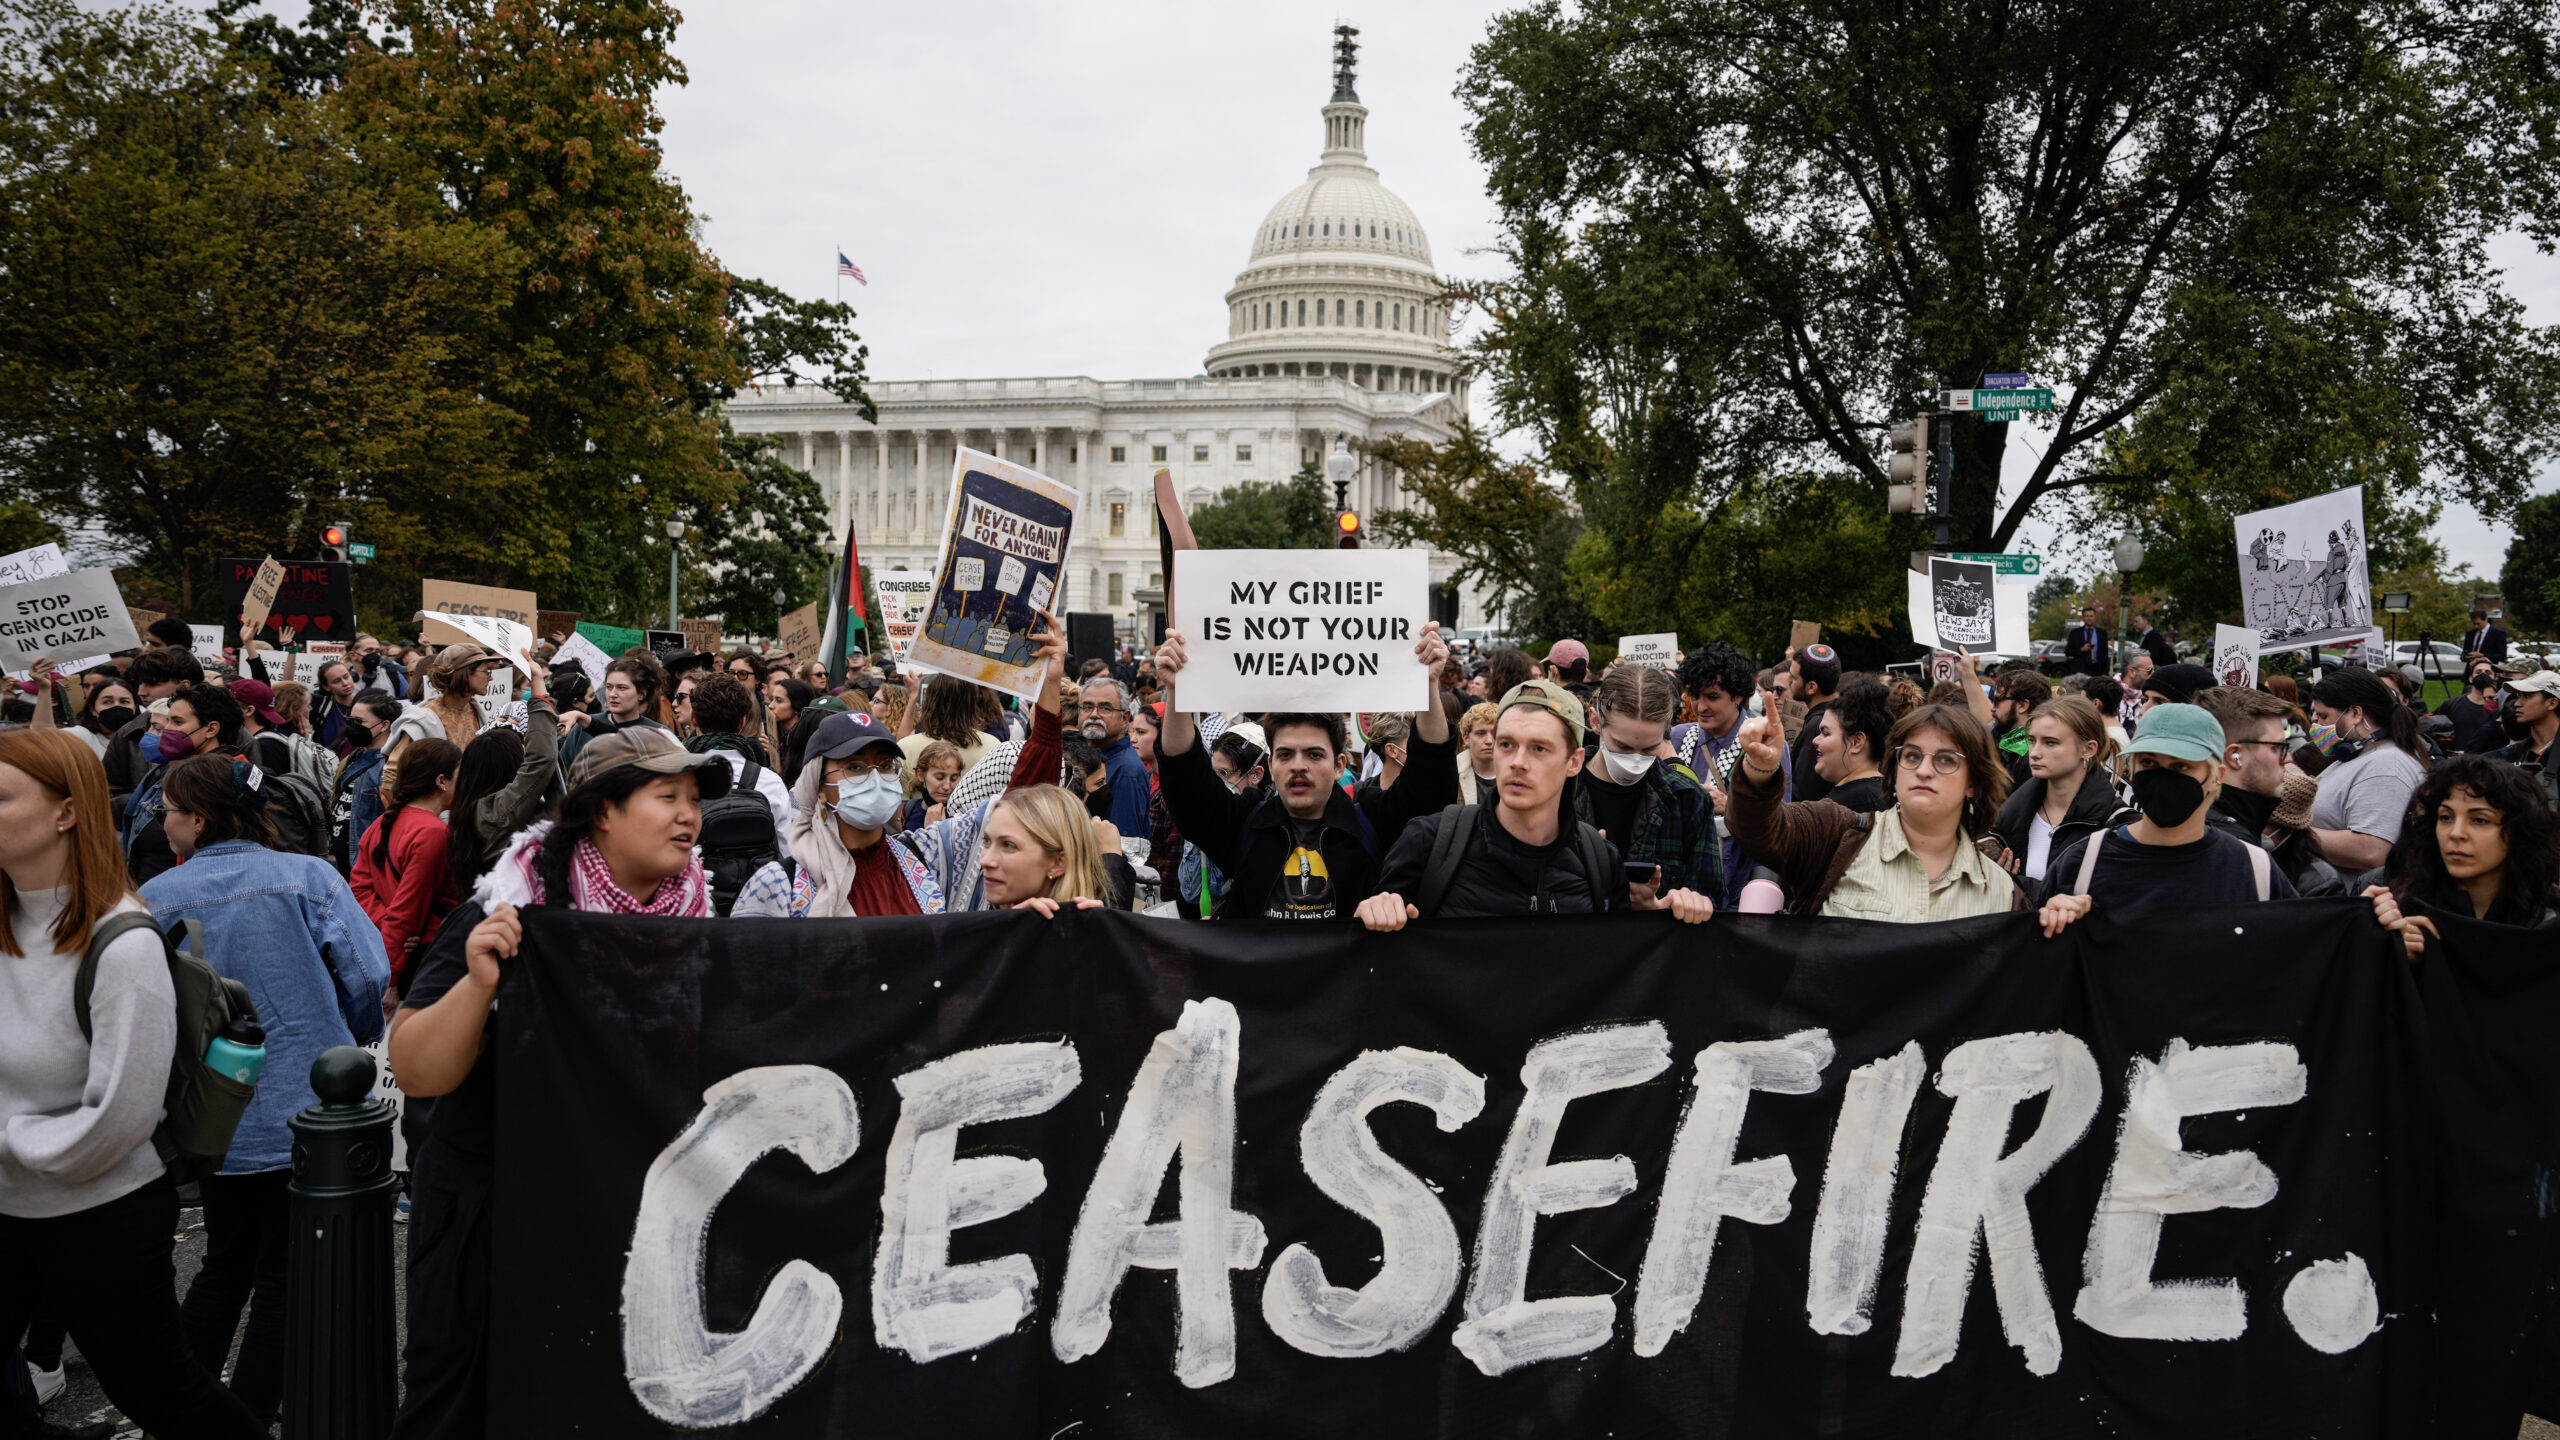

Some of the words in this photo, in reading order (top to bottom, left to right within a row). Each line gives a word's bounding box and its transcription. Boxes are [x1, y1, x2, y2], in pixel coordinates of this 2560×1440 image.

[1986, 377, 2010, 385] EVACUATION
[2012, 376, 2026, 384] ROUTE
[1978, 392, 2036, 410] Independence
[1988, 410, 2016, 421] UNIT
[972, 503, 1017, 536] NEVER
[1020, 522, 1057, 549] AGAIN
[974, 526, 998, 547] FOR
[1003, 538, 1051, 561] ANYONE
[234, 563, 329, 585] PASTINE
[260, 563, 279, 588] FREE
[958, 562, 982, 574] CEASE
[960, 575, 981, 585] FIRE!
[881, 594, 897, 603] PICK
[1231, 581, 1278, 604] MY
[1288, 581, 1383, 605] GRIEF
[16, 594, 71, 615] STOP
[436, 601, 489, 617] CEASE
[0, 605, 110, 636] GENOCIDE
[1204, 617, 1232, 641] IS
[1244, 617, 1310, 641] NOT
[1320, 617, 1410, 641] YOUR
[1939, 614, 1963, 626] JEWS
[1964, 619, 1985, 628] SAY
[17, 637, 39, 652] IN
[44, 626, 106, 647] GAZA
[576, 622, 595, 635] END
[600, 628, 616, 639] THE
[785, 626, 810, 652] FREE
[1953, 626, 1985, 634] GENOCIDE
[1624, 651, 1671, 661] GENOCIDE
[1635, 643, 1658, 651] STOP
[1233, 652, 1378, 676] WEAPON
[1264, 908, 1283, 919] John
[620, 997, 2383, 1430] CEASEFIRE.
